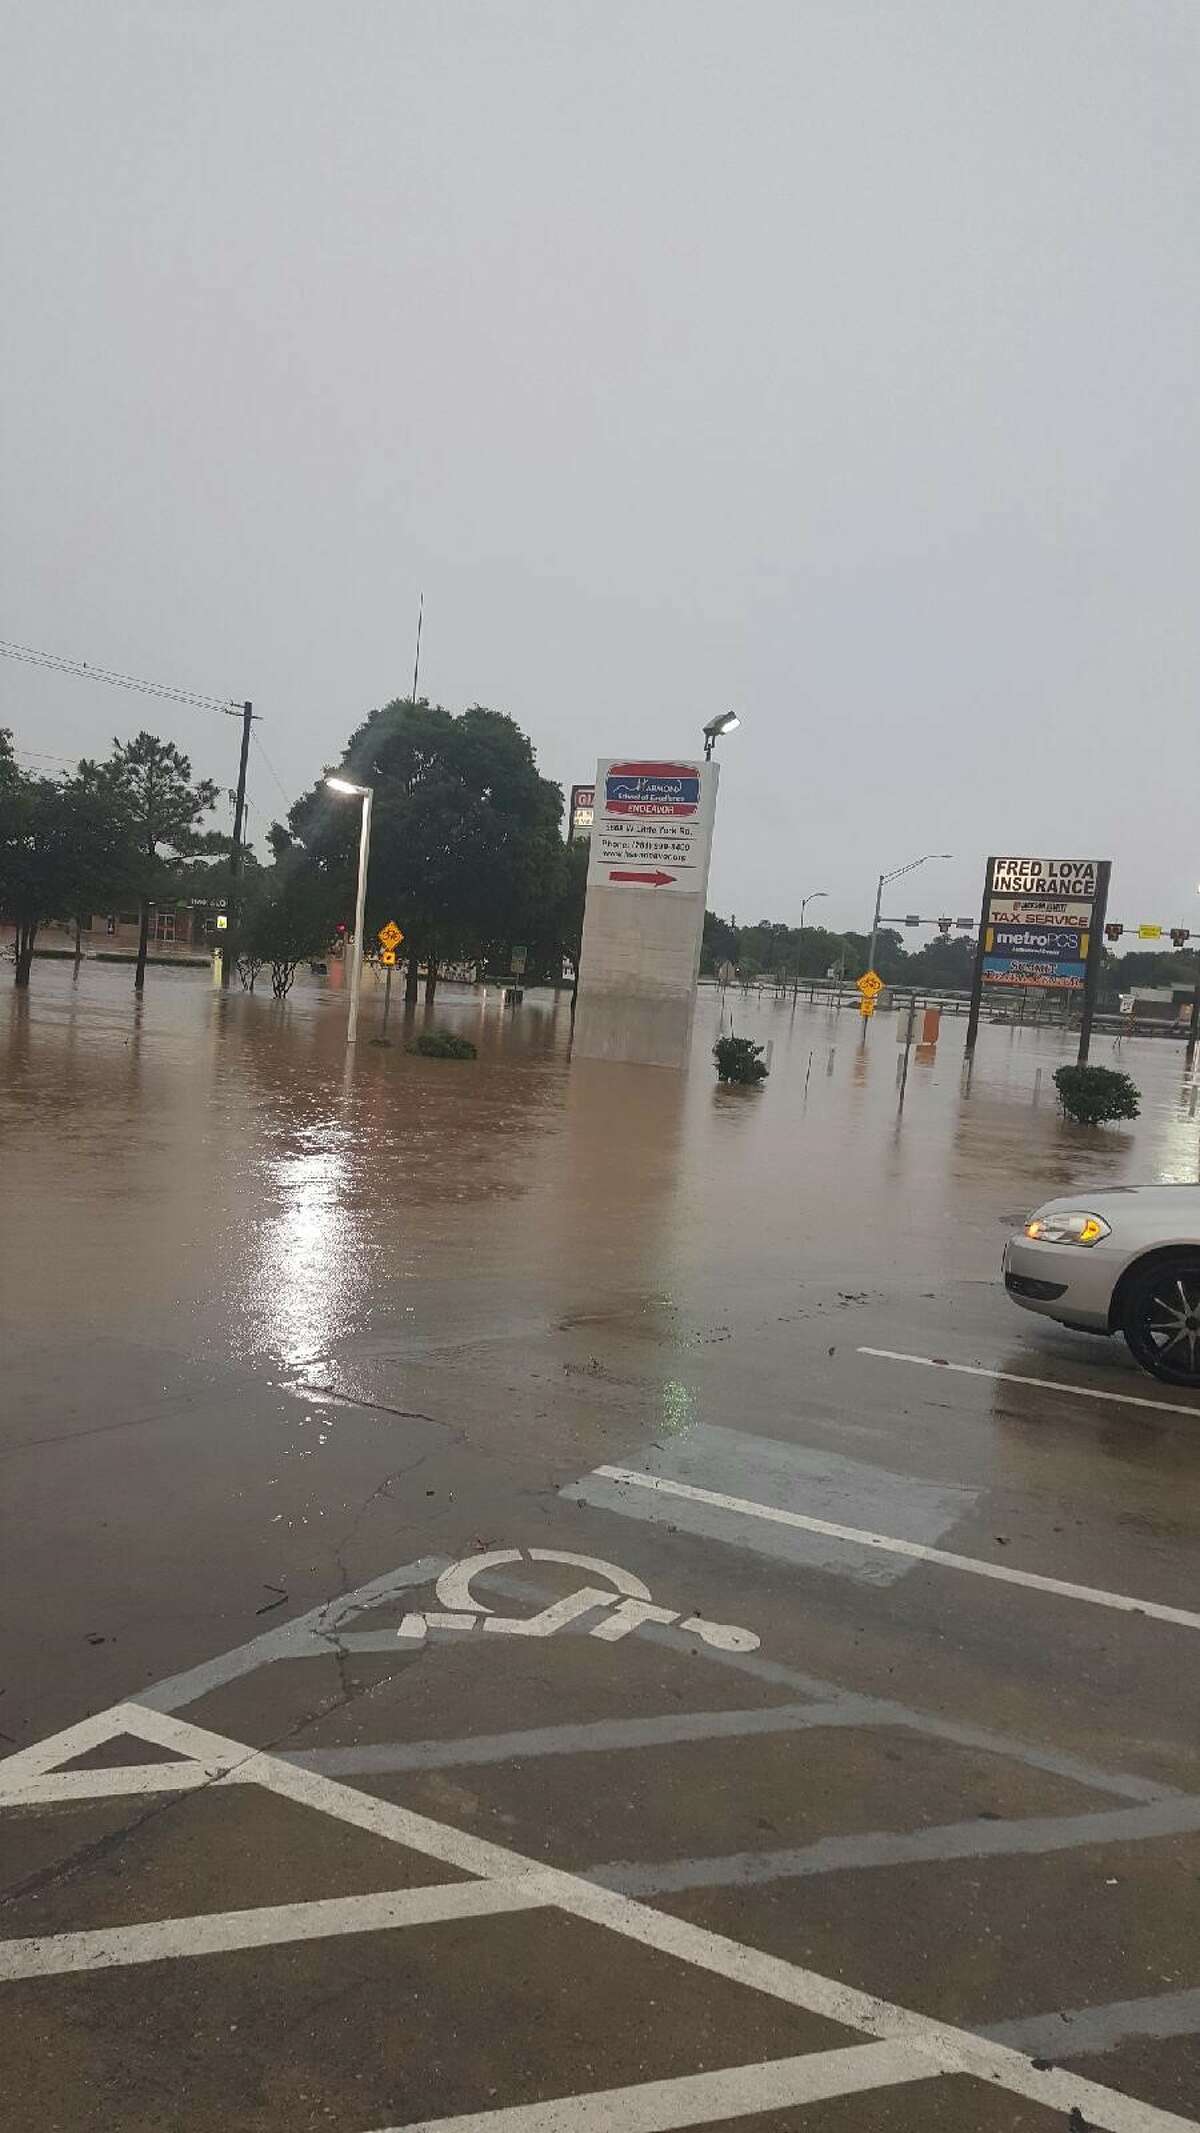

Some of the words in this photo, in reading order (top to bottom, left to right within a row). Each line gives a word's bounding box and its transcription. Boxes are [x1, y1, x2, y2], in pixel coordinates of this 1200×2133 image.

[996, 860, 1042, 877] FRED
[1048, 862, 1095, 879] LOYA
[994, 876, 1095, 895] INSURANCE
[992, 911, 1021, 923] TAX
[1025, 913, 1089, 927] SERVICE
[997, 931, 1078, 949] metroPCS
